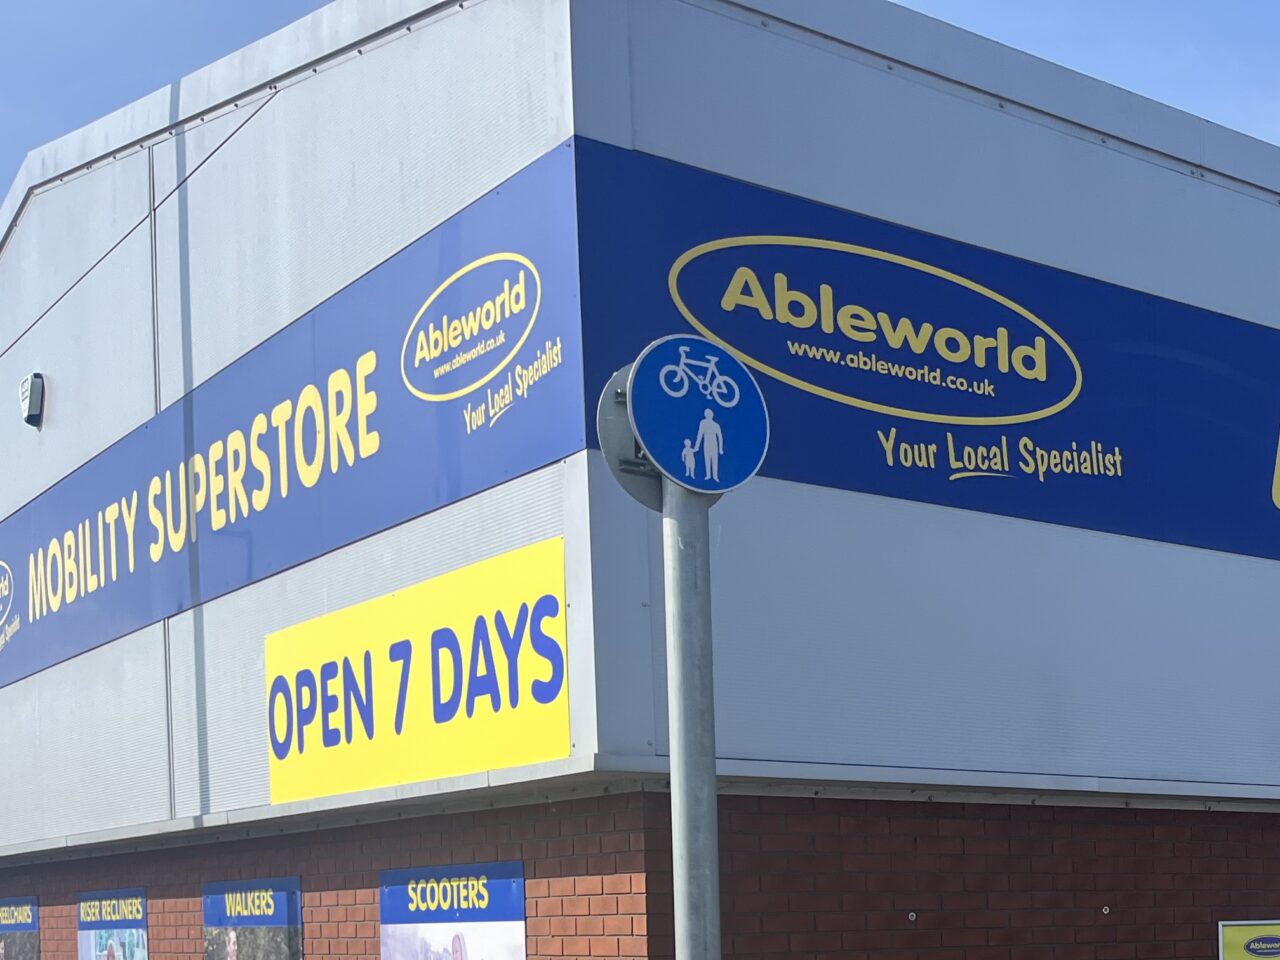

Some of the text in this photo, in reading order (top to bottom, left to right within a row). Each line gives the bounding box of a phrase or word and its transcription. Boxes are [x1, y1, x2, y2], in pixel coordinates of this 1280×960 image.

[414, 269, 526, 368] Ableworld
[720, 266, 1047, 382] Ableworld
[433, 329, 506, 379] www.ableworld.co.uk
[786, 338, 995, 397] www.ableworld.co.uk
[463, 336, 562, 435] Your Local Specialist
[877, 427, 1123, 482] Your Local Specialist
[28, 349, 380, 624] MOBILITY SUPERSTORE
[268, 593, 565, 760] OPEN 7 DAYS
[80, 896, 143, 922] RISER RECLINERS
[225, 888, 275, 918] WALKERS
[408, 876, 490, 912] SCOOTERS
